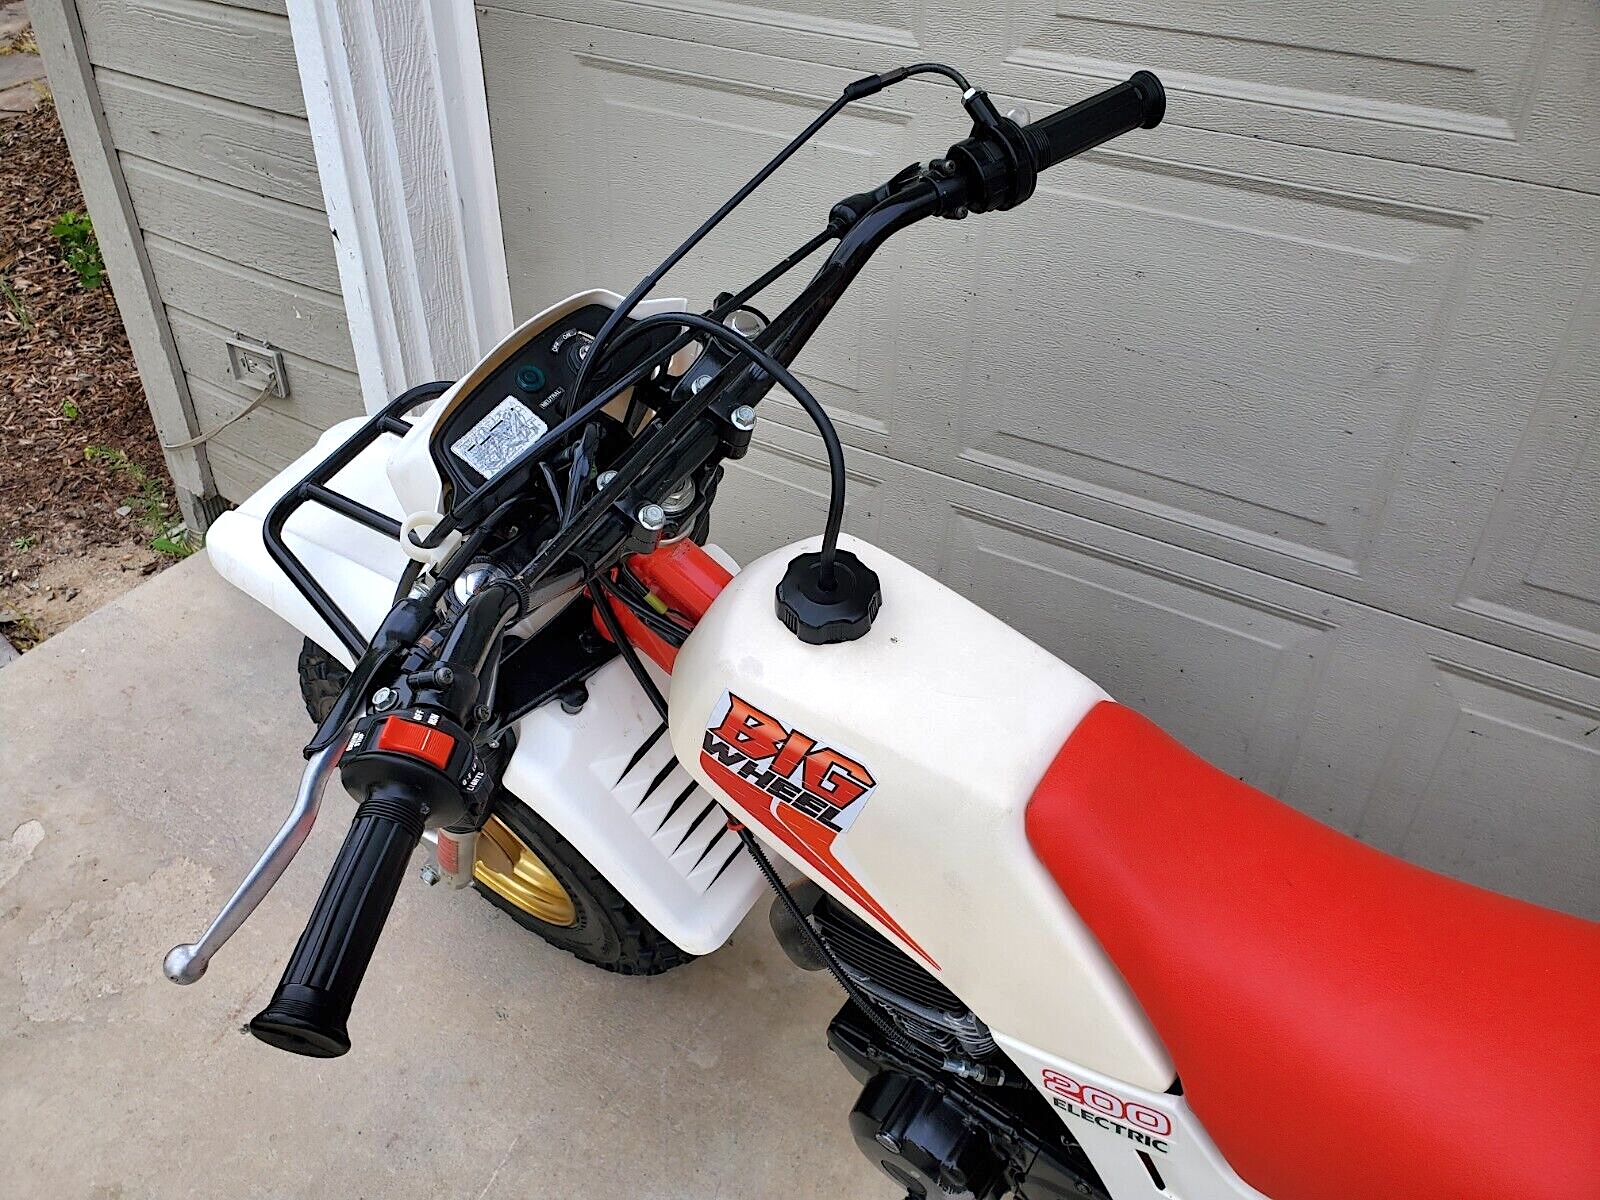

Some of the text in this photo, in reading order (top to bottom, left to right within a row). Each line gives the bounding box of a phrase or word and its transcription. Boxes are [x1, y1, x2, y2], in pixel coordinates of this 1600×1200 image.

[562, 332, 573, 340] ON
[540, 389, 562, 410] NEUTRAL
[707, 691, 877, 810] BIG
[467, 771, 484, 791] LIGHTS
[702, 730, 843, 833] WHEEL
[1042, 1069, 1172, 1136] 200
[1053, 1097, 1168, 1153] ELECTRIC
